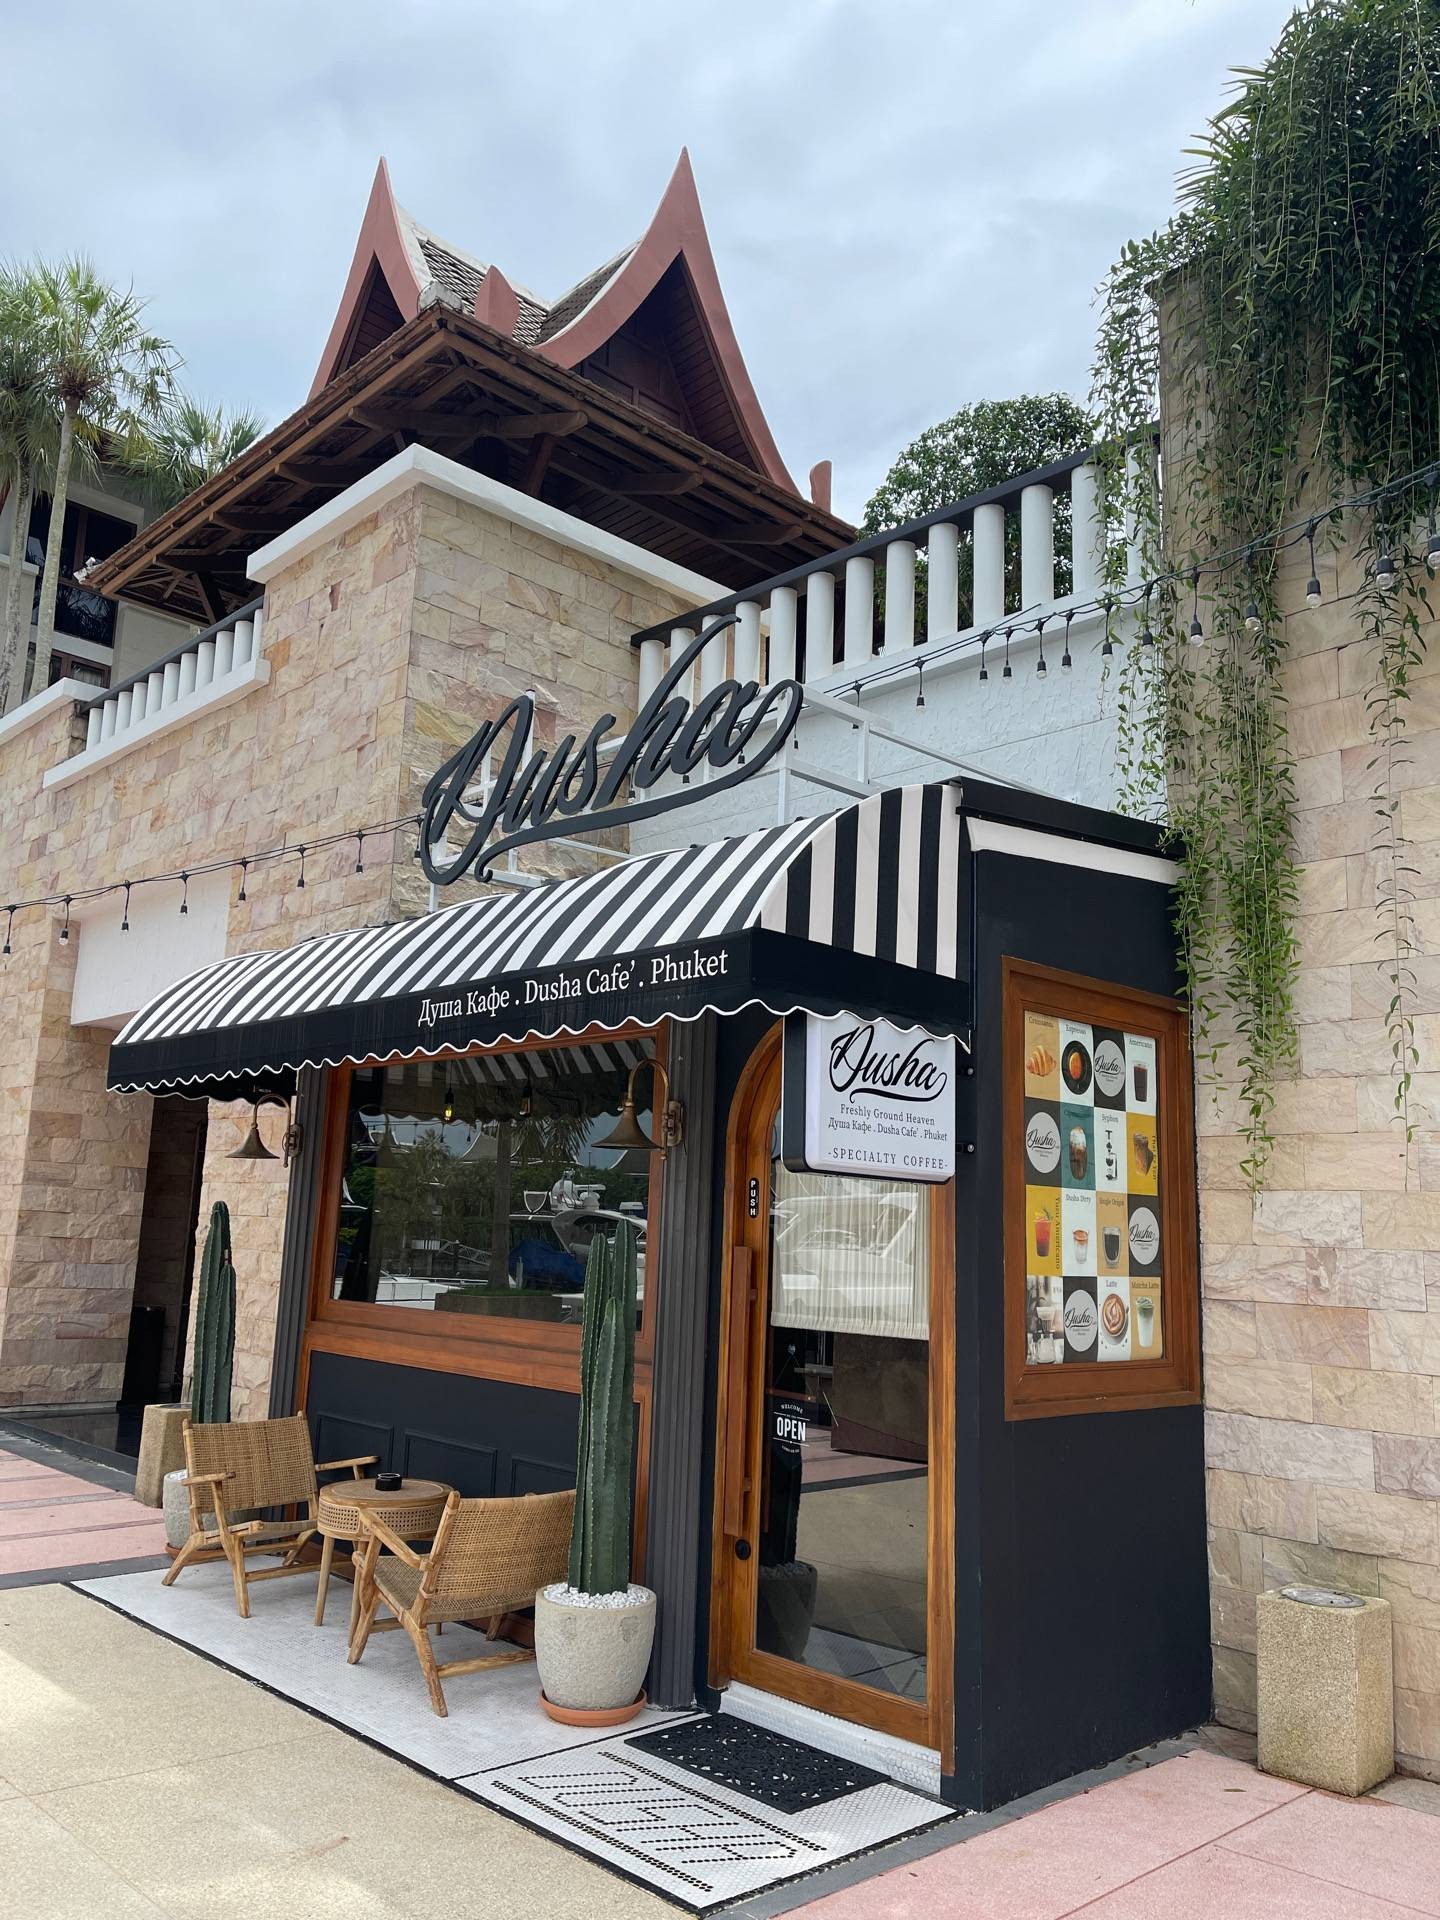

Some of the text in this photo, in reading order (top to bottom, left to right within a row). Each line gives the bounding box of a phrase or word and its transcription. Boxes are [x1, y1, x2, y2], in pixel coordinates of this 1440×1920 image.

[421, 614, 803, 886] Dusha
[418, 999, 462, 1027] Душа
[466, 986, 510, 1016] Кафе
[524, 973, 582, 1004] Dusha
[650, 949, 729, 984] Phuket
[829, 1025, 948, 1103] Dusha
[1095, 1055, 1121, 1075] Dusha
[840, 1104, 935, 1126] Freshly Ground Heaven
[828, 1117, 850, 1130] Душа
[852, 1120, 872, 1134] Кафе
[877, 1123, 900, 1135] Dusha
[924, 1129, 947, 1141] Phuket
[1027, 1129, 1055, 1150] Dusha
[1129, 1224, 1154, 1243] Dusha
[1065, 1308, 1093, 1329] Dusha
[780, 1404, 804, 1415] WELCOME
[776, 1416, 806, 1441] OPEN
